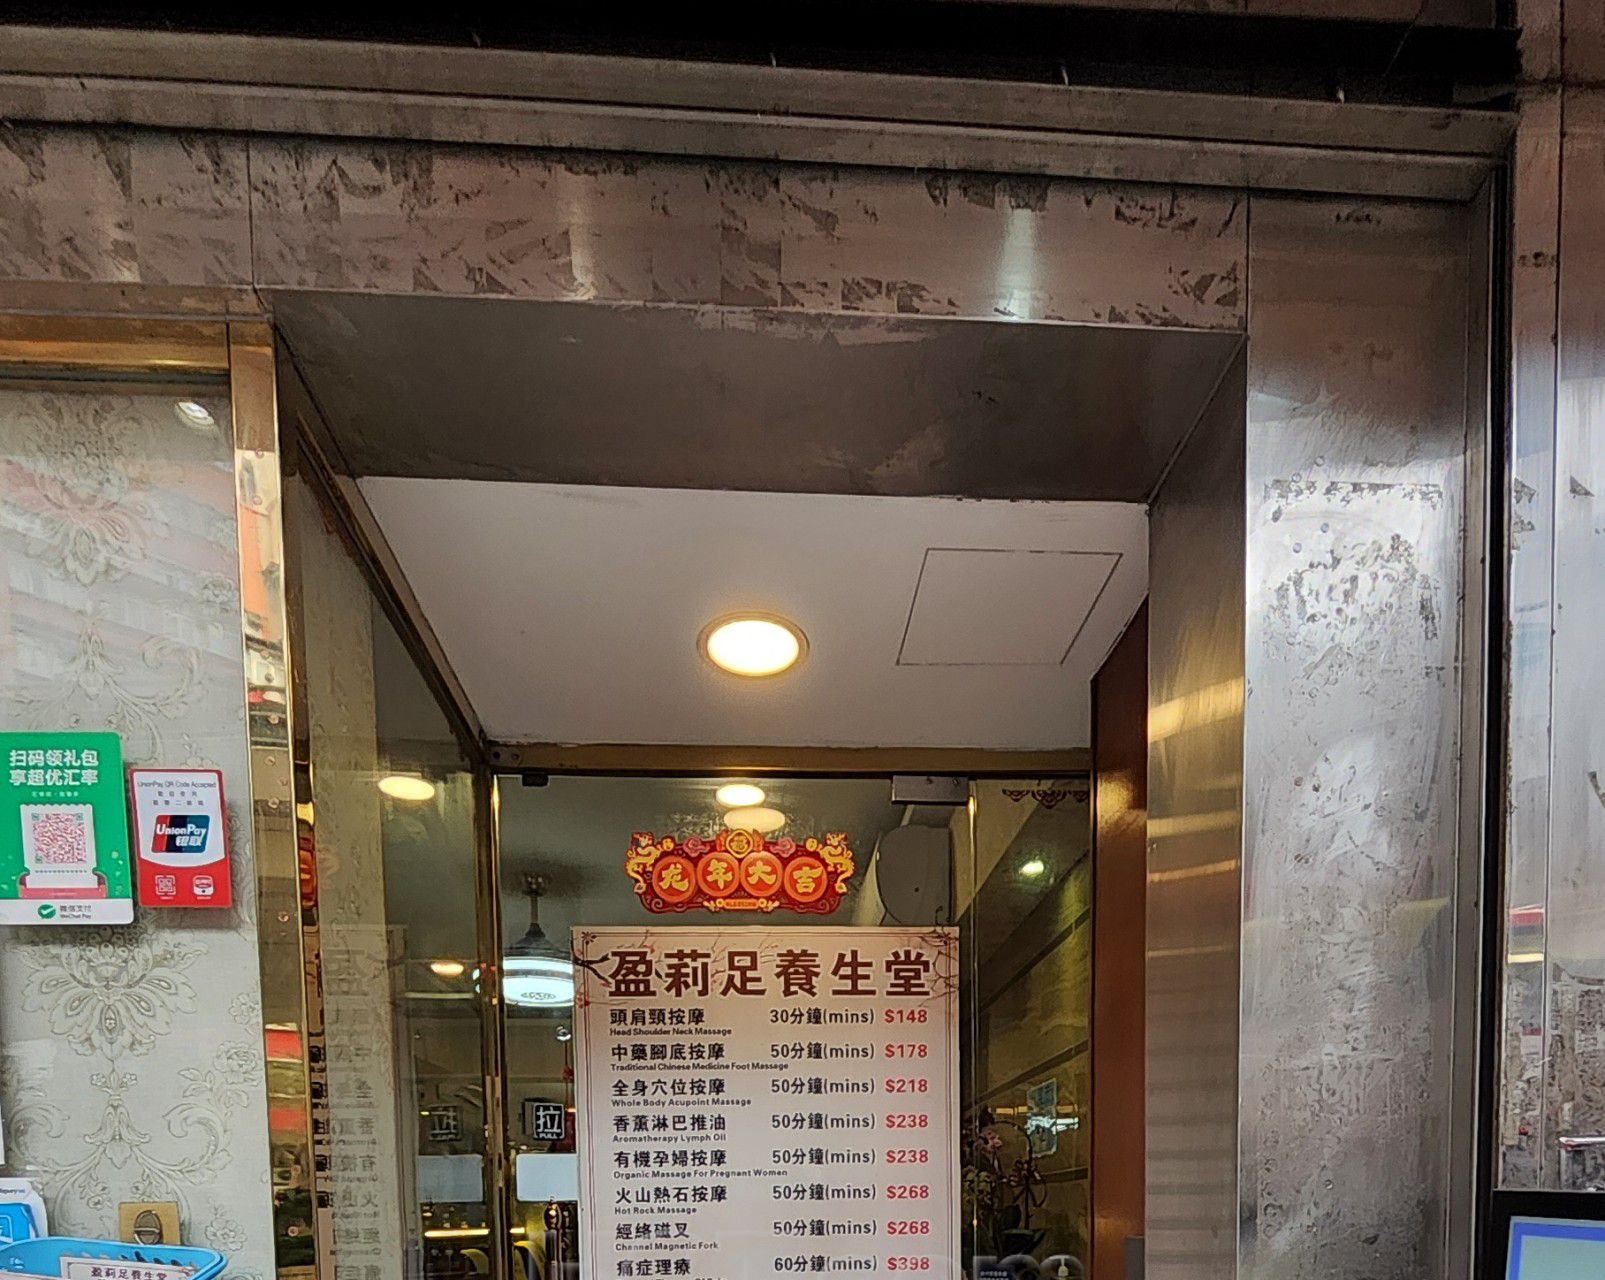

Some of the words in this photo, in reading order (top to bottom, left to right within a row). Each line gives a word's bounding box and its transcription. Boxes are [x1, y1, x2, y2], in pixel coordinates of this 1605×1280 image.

[9, 749, 98, 766] 扫码领礼包
[9, 769, 98, 786] 享超优汇率
[156, 823, 206, 837] UnionPay
[608, 948, 932, 998] 盈莉足養生堂
[609, 1008, 705, 1026] 頭肩頸按摩
[769, 1007, 875, 1026] 30分鐘(mins)
[884, 1008, 928, 1024] $148
[610, 1028, 631, 1036] Head
[633, 1027, 671, 1036] Shoulder
[672, 1027, 694, 1035] Neck
[695, 1027, 732, 1036] Massage
[770, 1042, 875, 1061] 50分鐘(mins)
[884, 1043, 928, 1059] $178
[611, 1063, 656, 1071] Traditional
[658, 1063, 691, 1071] Chinese
[731, 1062, 750, 1070] Foot
[751, 1062, 789, 1071] Massage
[612, 1078, 726, 1097] 全身穴位按摩
[771, 1077, 875, 1097] 50分鐘(mins)
[885, 1079, 928, 1094] $218
[643, 1099, 666, 1107] Body
[668, 1099, 710, 1107] Acupoint
[711, 1099, 752, 1107] Massage
[536, 1106, 562, 1132] 拉
[771, 1113, 876, 1132] 50分鐘(mins)
[886, 1114, 929, 1129] $238
[612, 1135, 678, 1143] Aromatherapy
[680, 1134, 711, 1143] Lymph
[713, 1133, 727, 1141] Oil
[613, 1150, 727, 1168] 有機孕婦按摩
[772, 1148, 876, 1167] 50分鐘(mins)
[886, 1150, 929, 1164] $238
[613, 1171, 649, 1180] Organic
[651, 1170, 692, 1179] Massage
[710, 1170, 751, 1179] Pregnant
[615, 1185, 727, 1204] 火山熱石按摩
[772, 1184, 876, 1202] 50分鐘(mins)
[886, 1185, 930, 1200] $268
[614, 1207, 631, 1215] Hot
[633, 1206, 655, 1214] Rock
[657, 1206, 697, 1215] Massage
[615, 1222, 690, 1240] 經絡磁叉
[773, 1219, 877, 1238] 50分鐘(mins)
[887, 1221, 930, 1235] $268
[654, 1242, 696, 1251] Magnetic
[698, 1241, 718, 1249] Fork
[616, 1259, 691, 1277] 痛症理療
[774, 1255, 877, 1273] 60分鐘(mins)
[888, 1257, 930, 1271] $398
